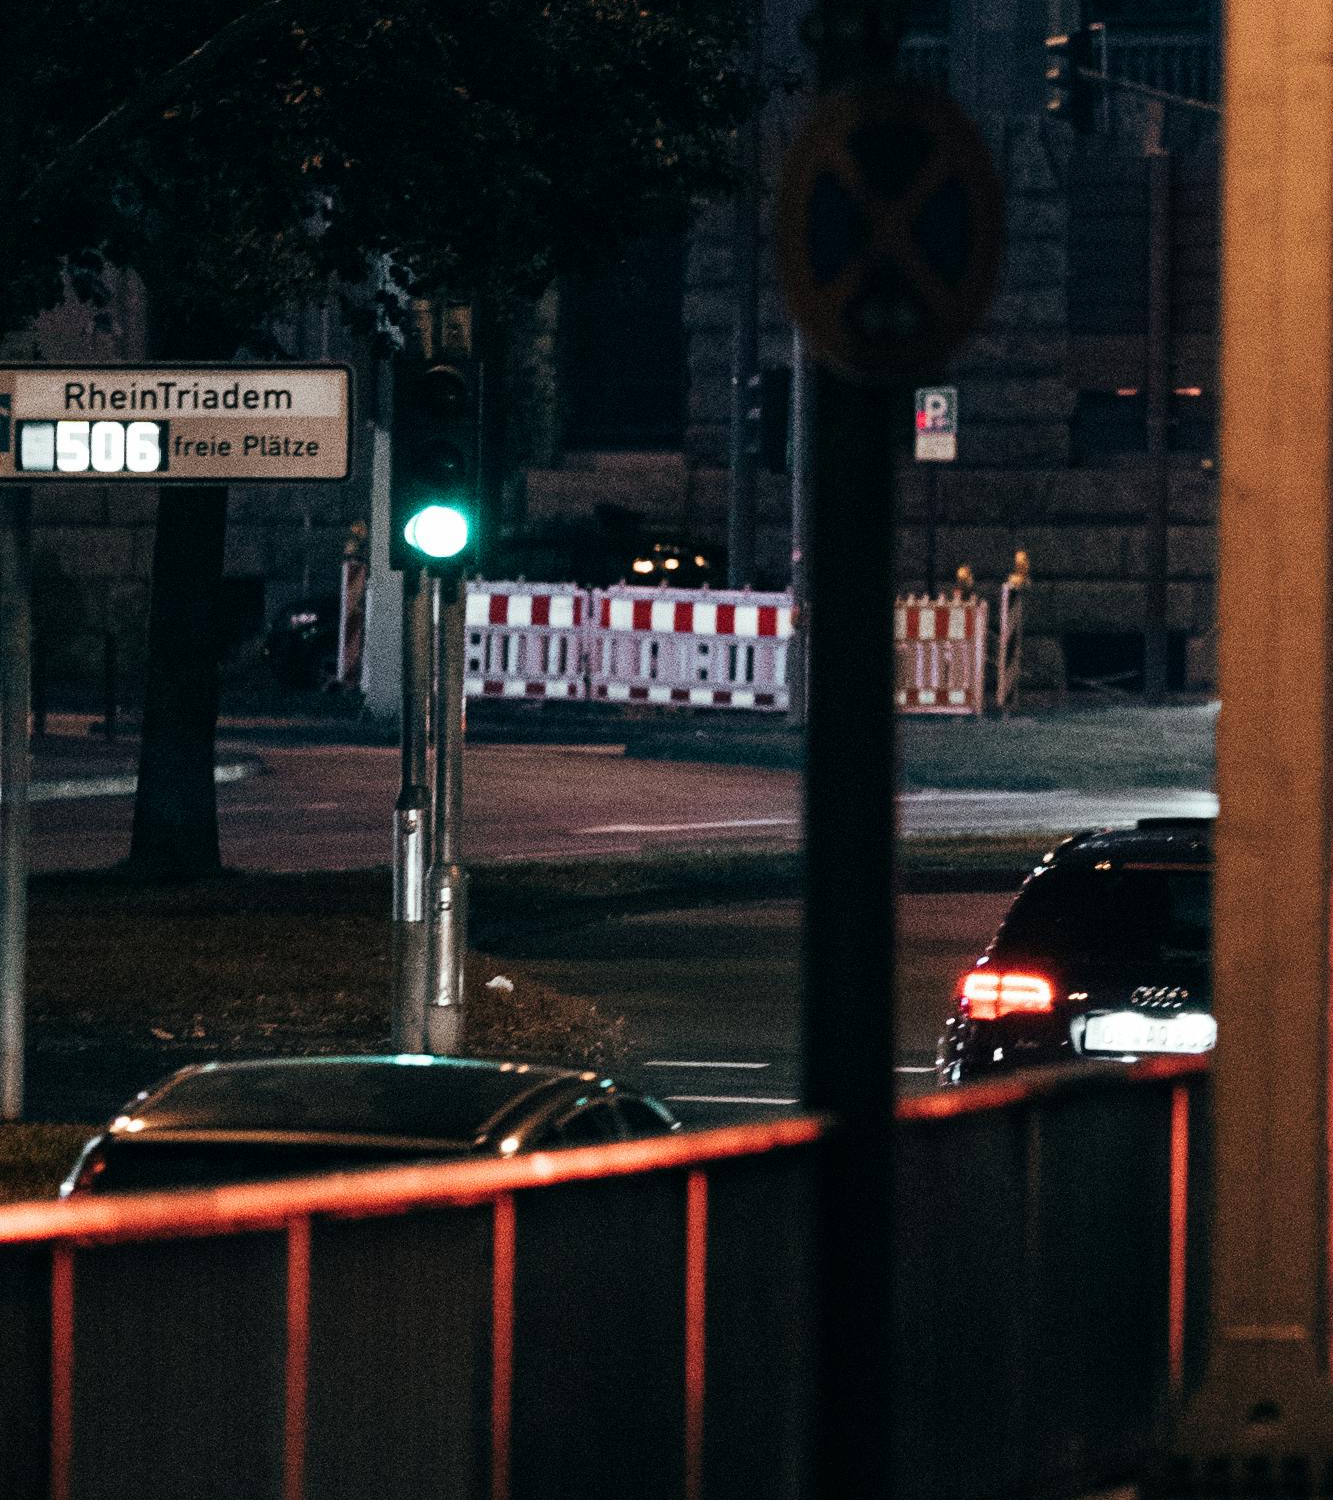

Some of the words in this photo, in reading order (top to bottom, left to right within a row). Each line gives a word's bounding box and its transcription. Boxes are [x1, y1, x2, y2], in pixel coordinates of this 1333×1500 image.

[64, 382, 293, 411] RheinTriadem
[56, 420, 162, 472] 506
[174, 436, 232, 457] freie
[242, 434, 320, 457] Plätze
